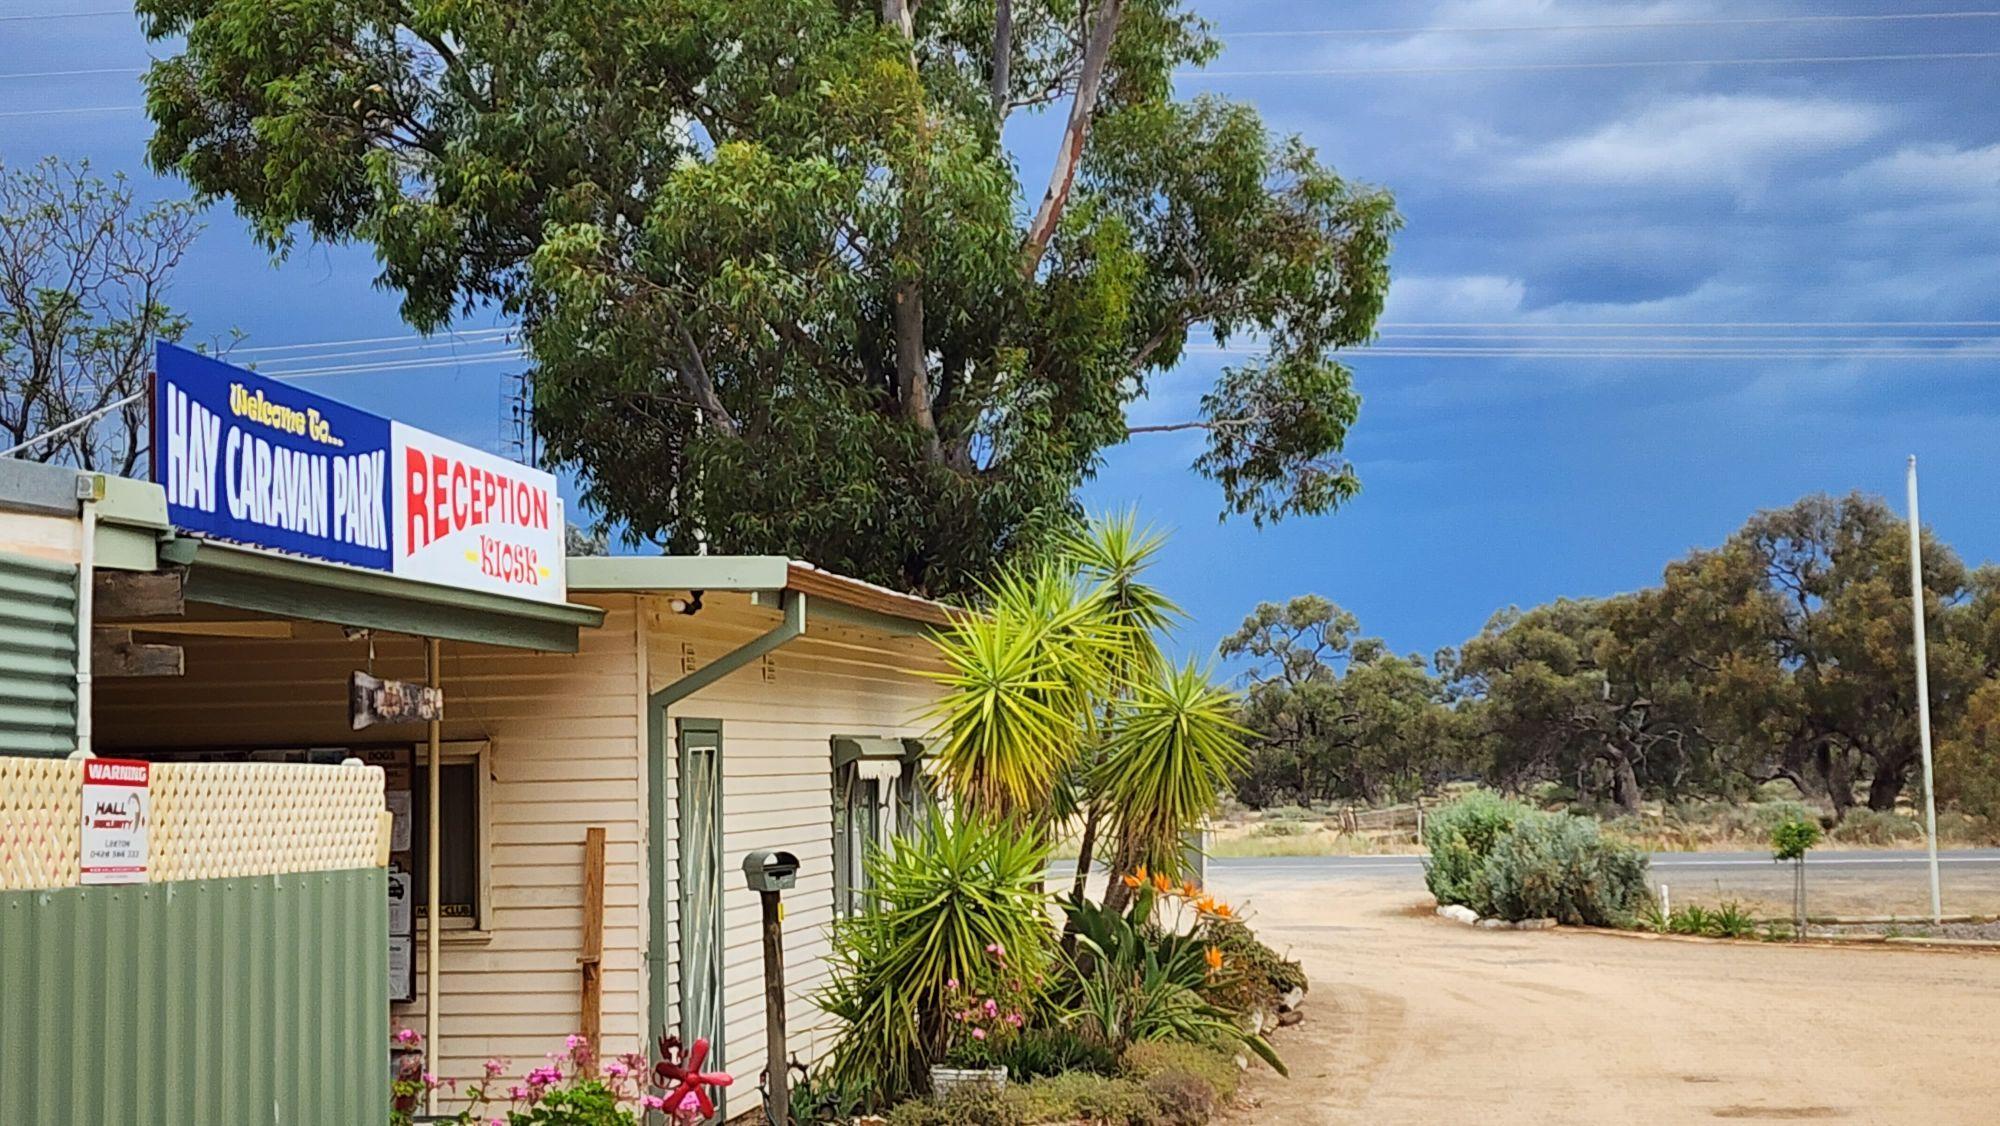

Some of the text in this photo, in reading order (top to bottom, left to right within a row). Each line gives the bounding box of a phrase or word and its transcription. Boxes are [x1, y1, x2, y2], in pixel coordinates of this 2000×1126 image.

[229, 382, 306, 436] Welcome
[167, 381, 387, 551] HAY CARAVAN PARK
[406, 446, 549, 557] RECEPTION
[480, 534, 538, 586] KIOSK
[89, 764, 146, 782] WARNING
[95, 802, 127, 816] HALL
